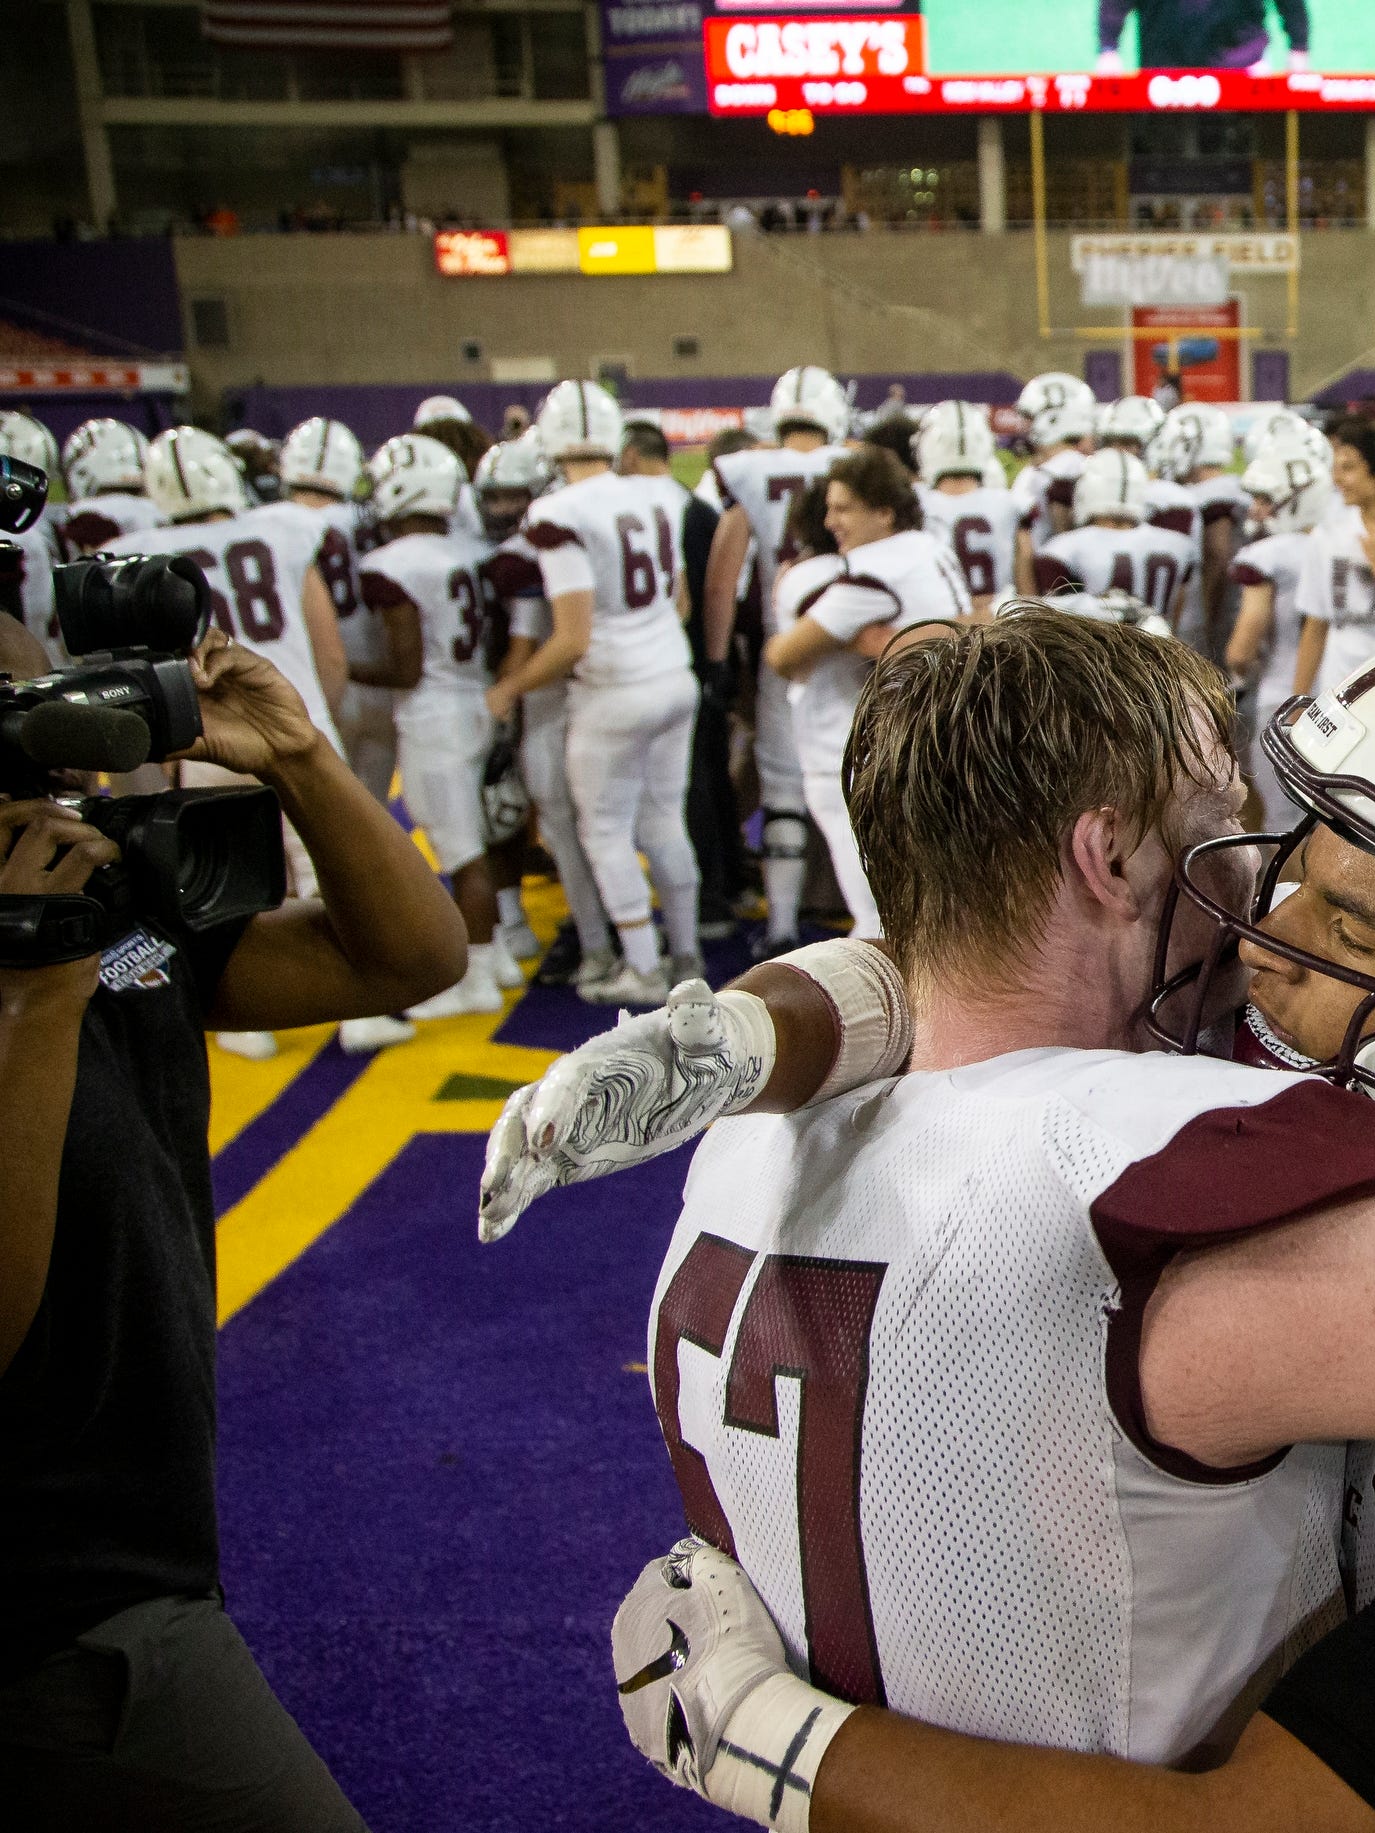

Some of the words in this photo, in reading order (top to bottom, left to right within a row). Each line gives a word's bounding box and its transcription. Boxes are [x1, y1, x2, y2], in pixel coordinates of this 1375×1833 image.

[726, 22, 908, 76] CASEY'S
[101, 686, 130, 700] SONY
[98, 936, 164, 985] FOOTBALL
